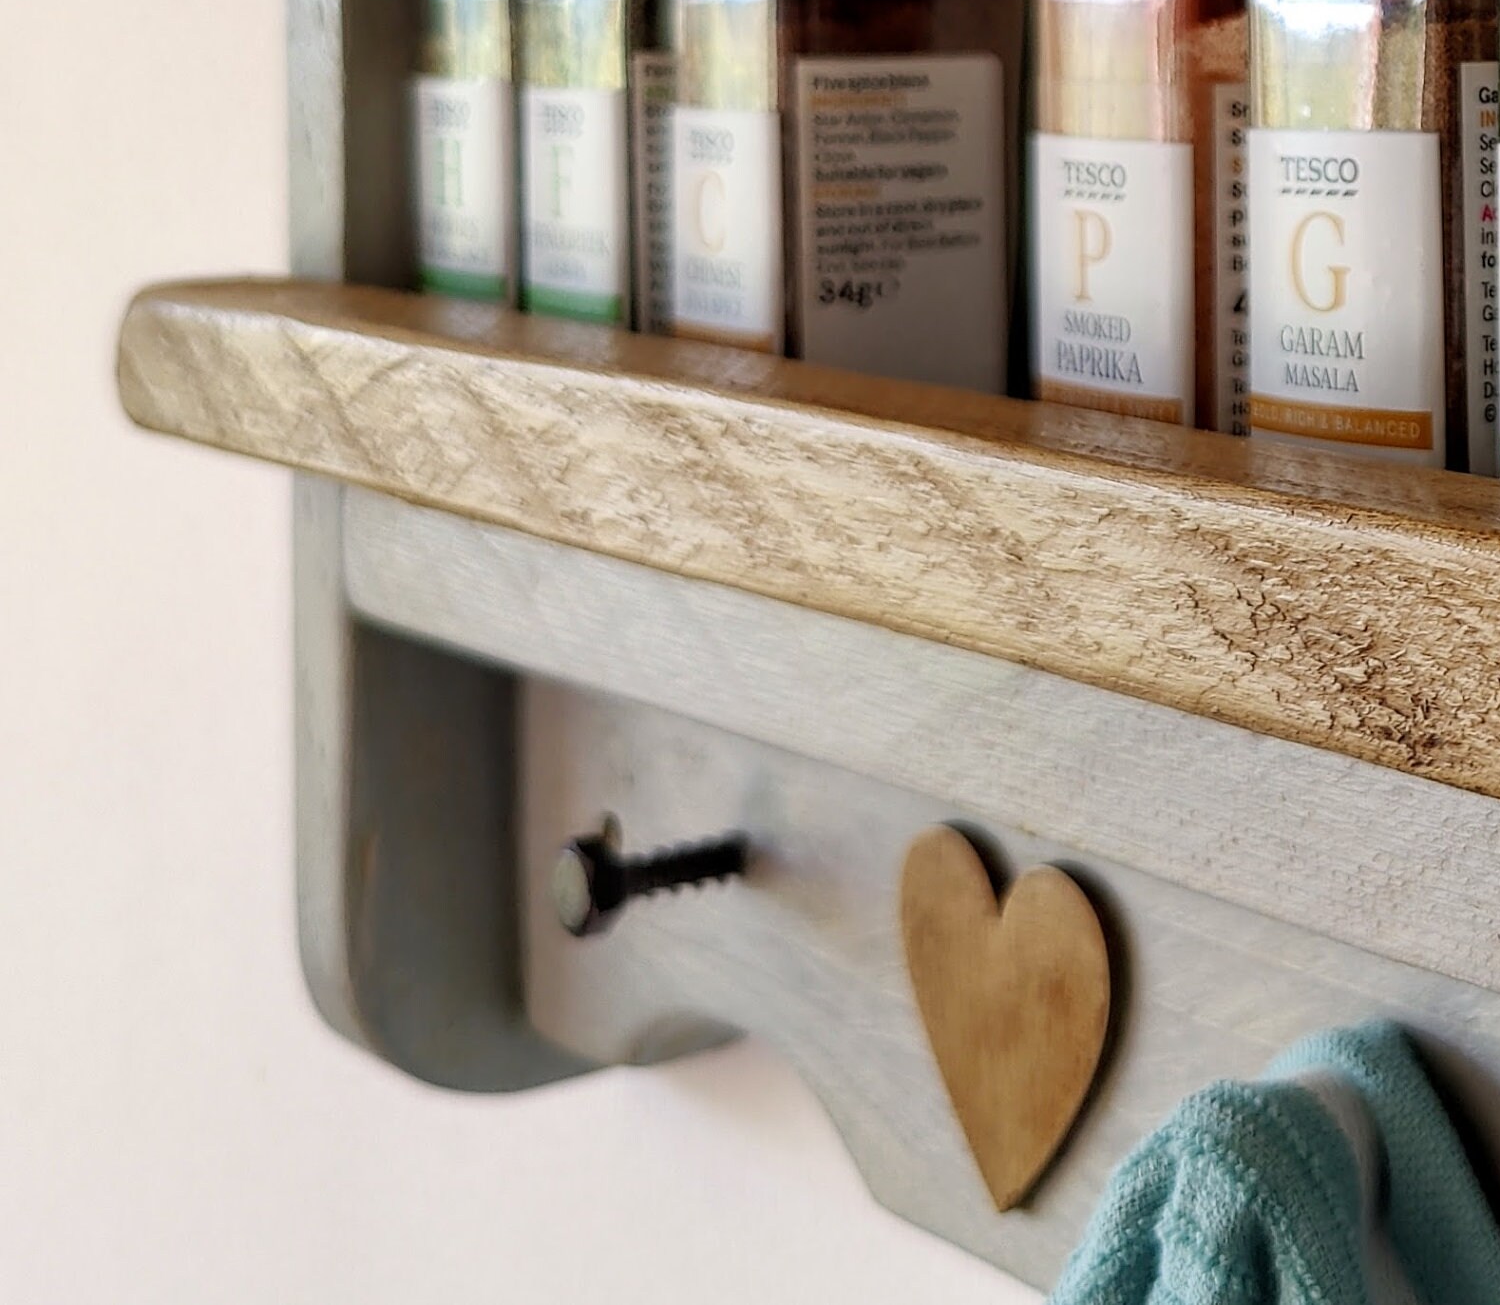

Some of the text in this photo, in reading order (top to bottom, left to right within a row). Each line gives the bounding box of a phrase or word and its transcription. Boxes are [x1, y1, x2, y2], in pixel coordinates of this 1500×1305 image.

[1063, 160, 1126, 189] TESCO
[1280, 156, 1359, 183] TESCO
[1073, 208, 1113, 302] P
[1291, 210, 1352, 313] G
[1064, 309, 1132, 343] SMOKED
[1280, 325, 1365, 360] GARAM
[1056, 340, 1144, 385] PAPRIKA
[1285, 362, 1360, 393] MASALA
[1335, 414, 1421, 439] BALANCED
